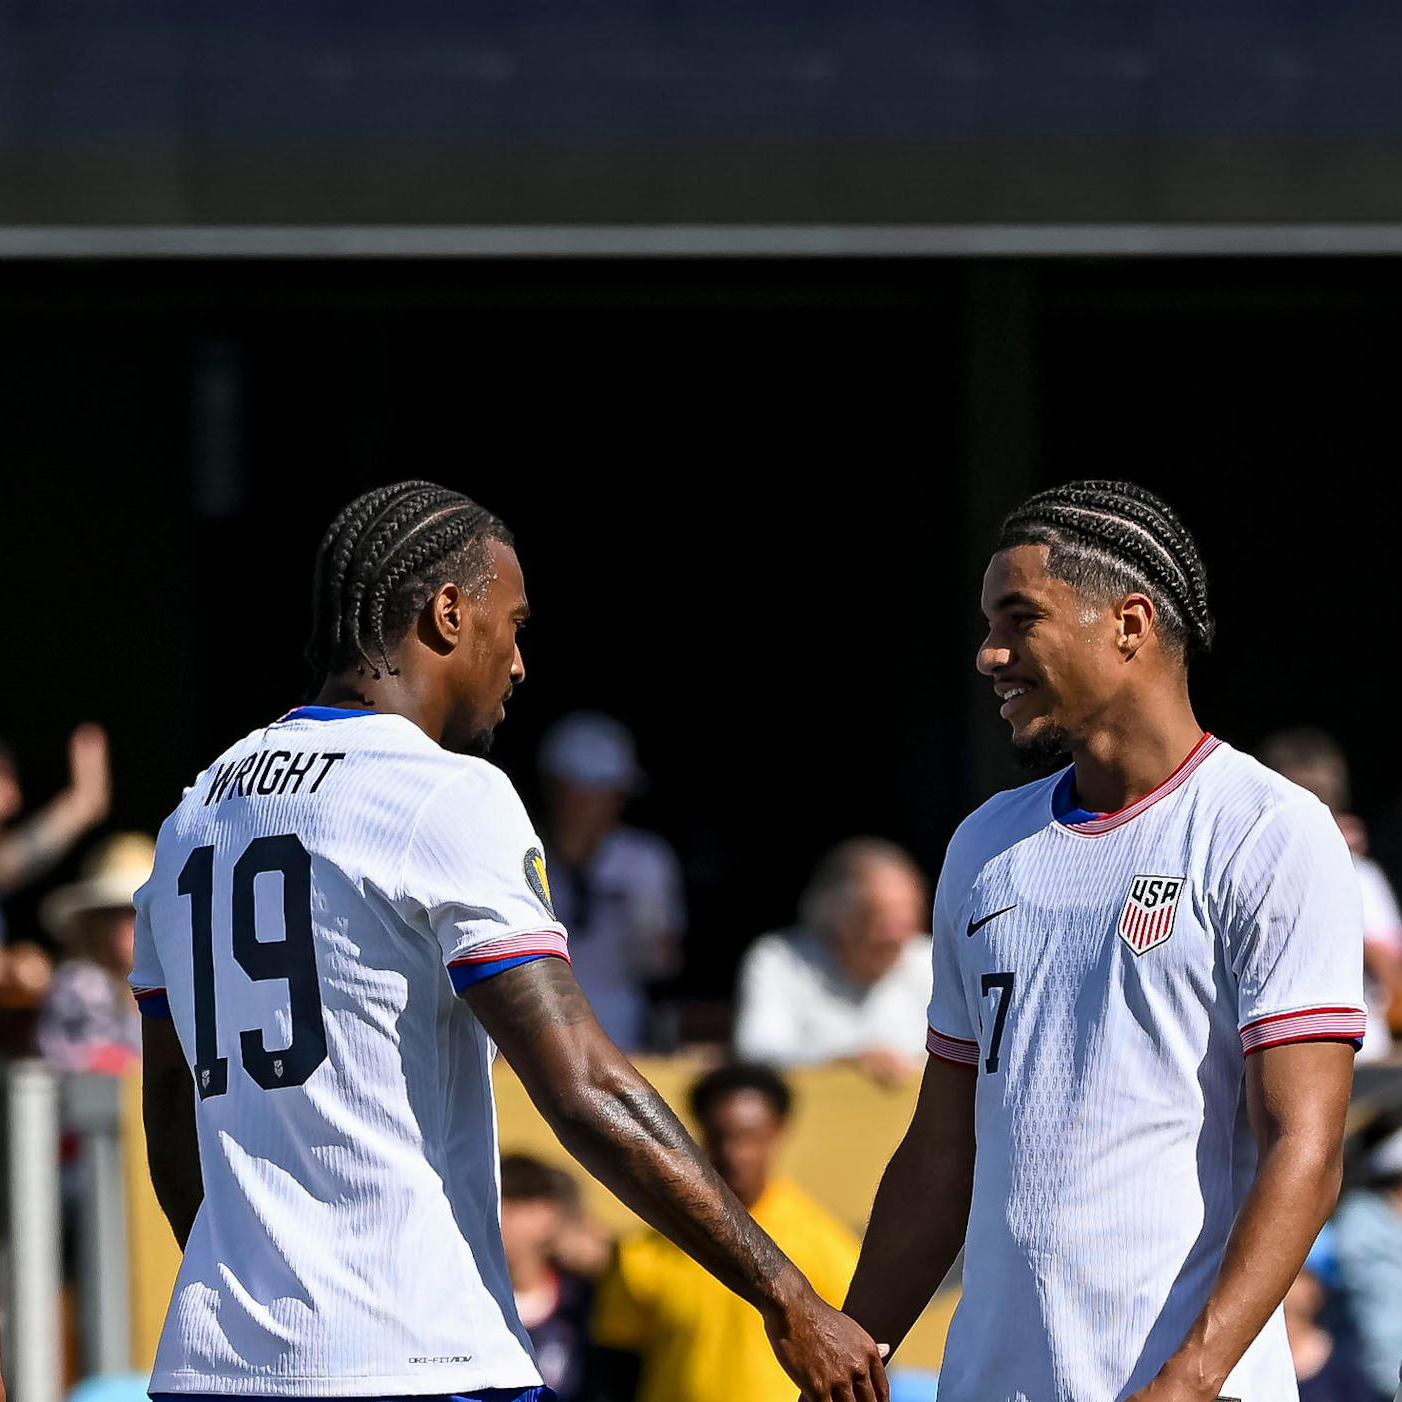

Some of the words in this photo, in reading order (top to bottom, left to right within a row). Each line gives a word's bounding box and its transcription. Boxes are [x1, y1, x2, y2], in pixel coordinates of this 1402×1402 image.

[205, 750, 346, 806] WRIGHT
[1132, 880, 1179, 908] USA
[178, 833, 327, 1101] 19
[979, 972, 1015, 1074] 7
